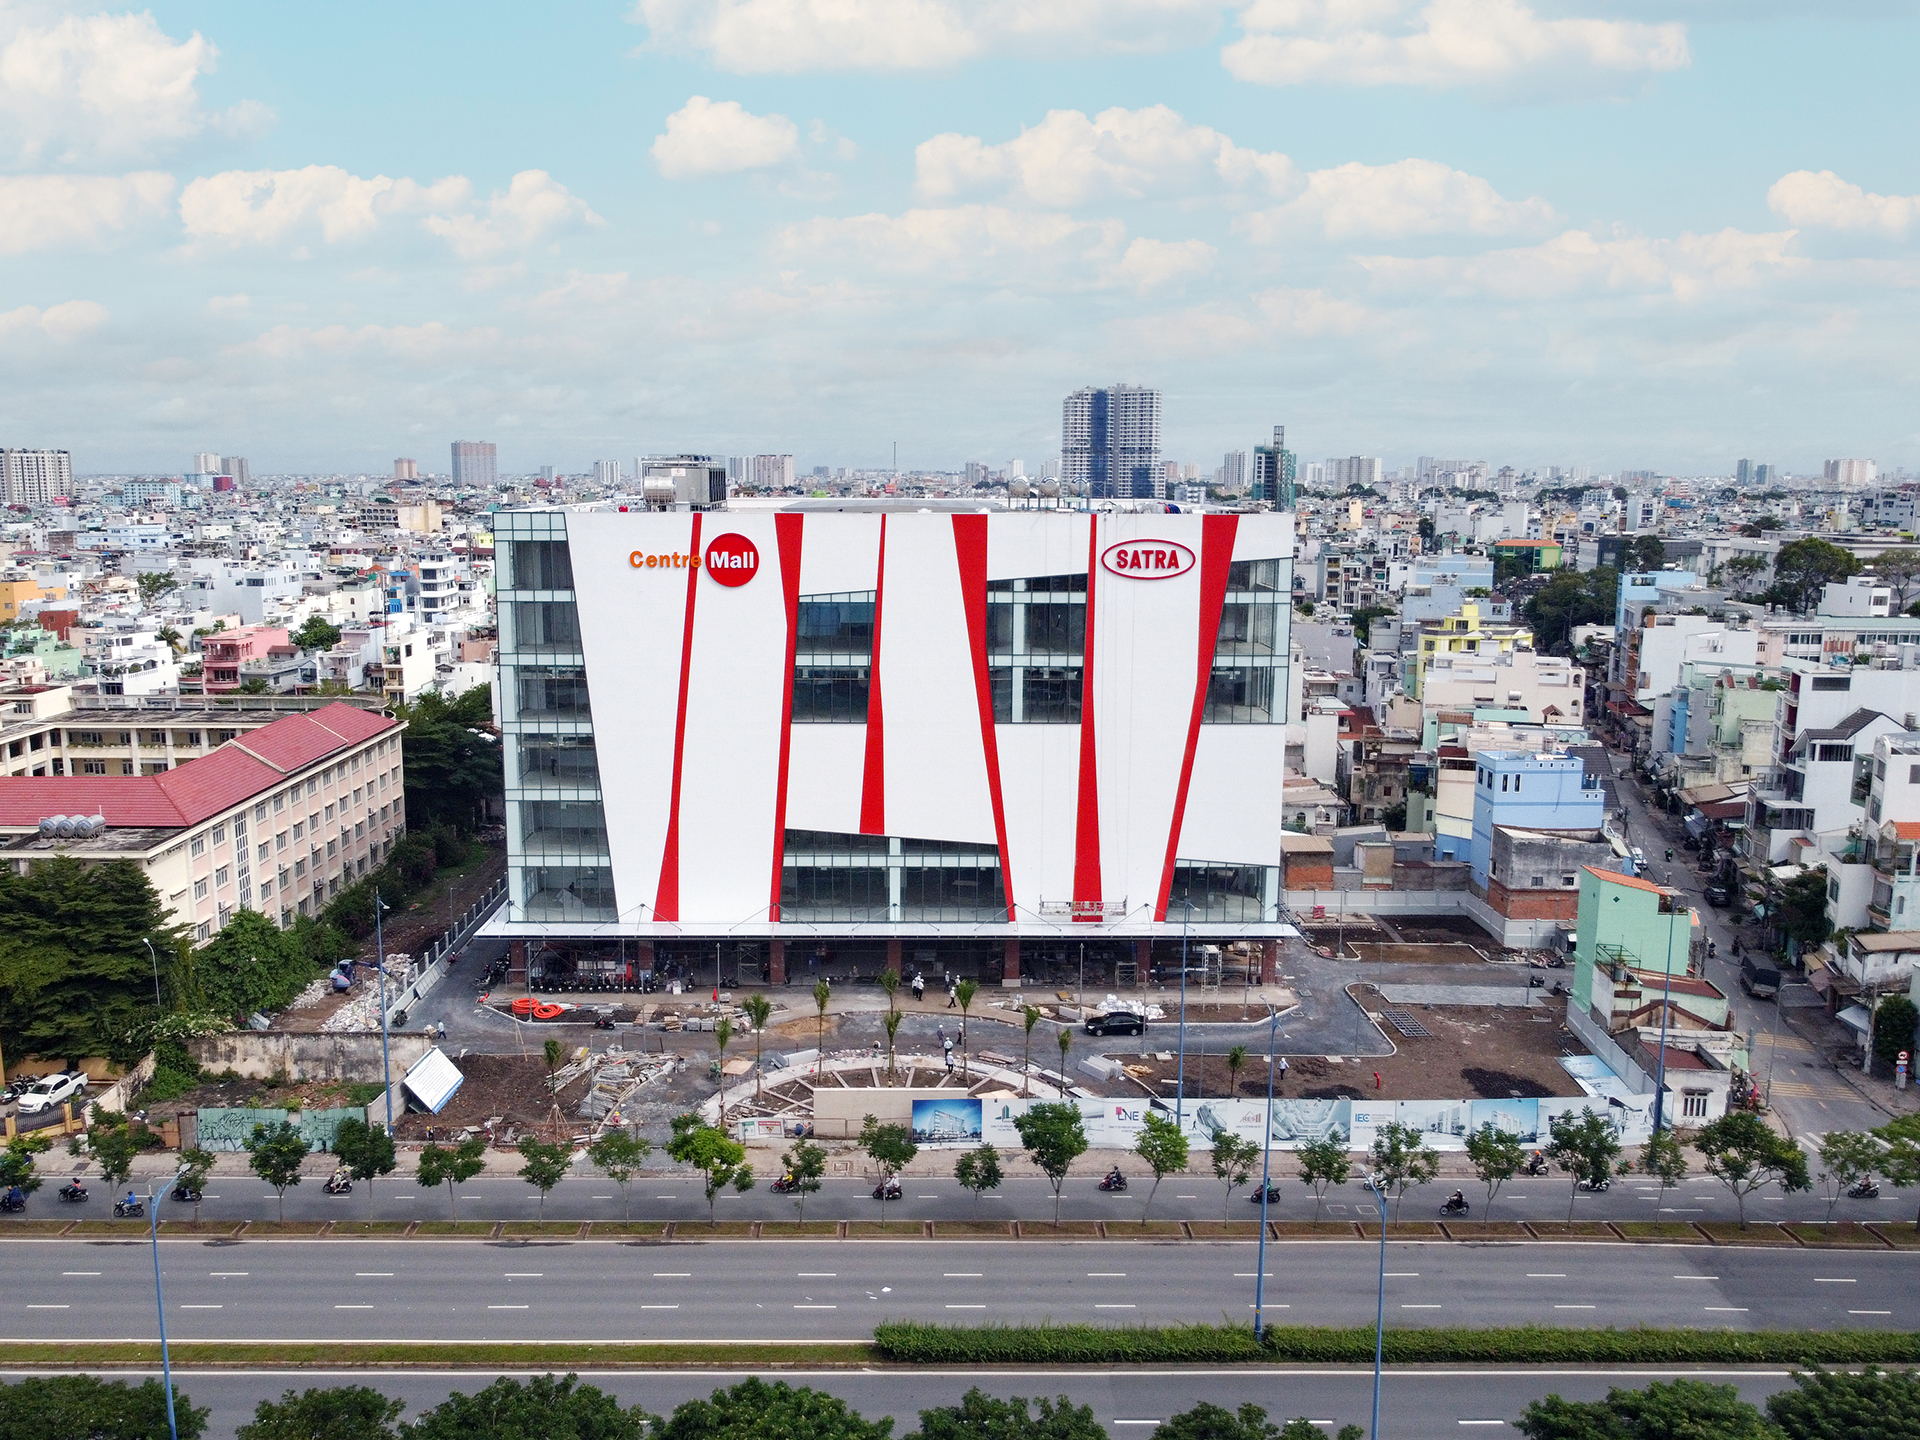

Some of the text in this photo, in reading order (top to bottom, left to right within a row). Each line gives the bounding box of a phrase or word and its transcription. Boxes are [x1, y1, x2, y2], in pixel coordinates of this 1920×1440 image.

[629, 550, 754, 569] Centre Mall
[1116, 549, 1179, 569] SATRA
[1355, 1113, 1370, 1122] IEC
